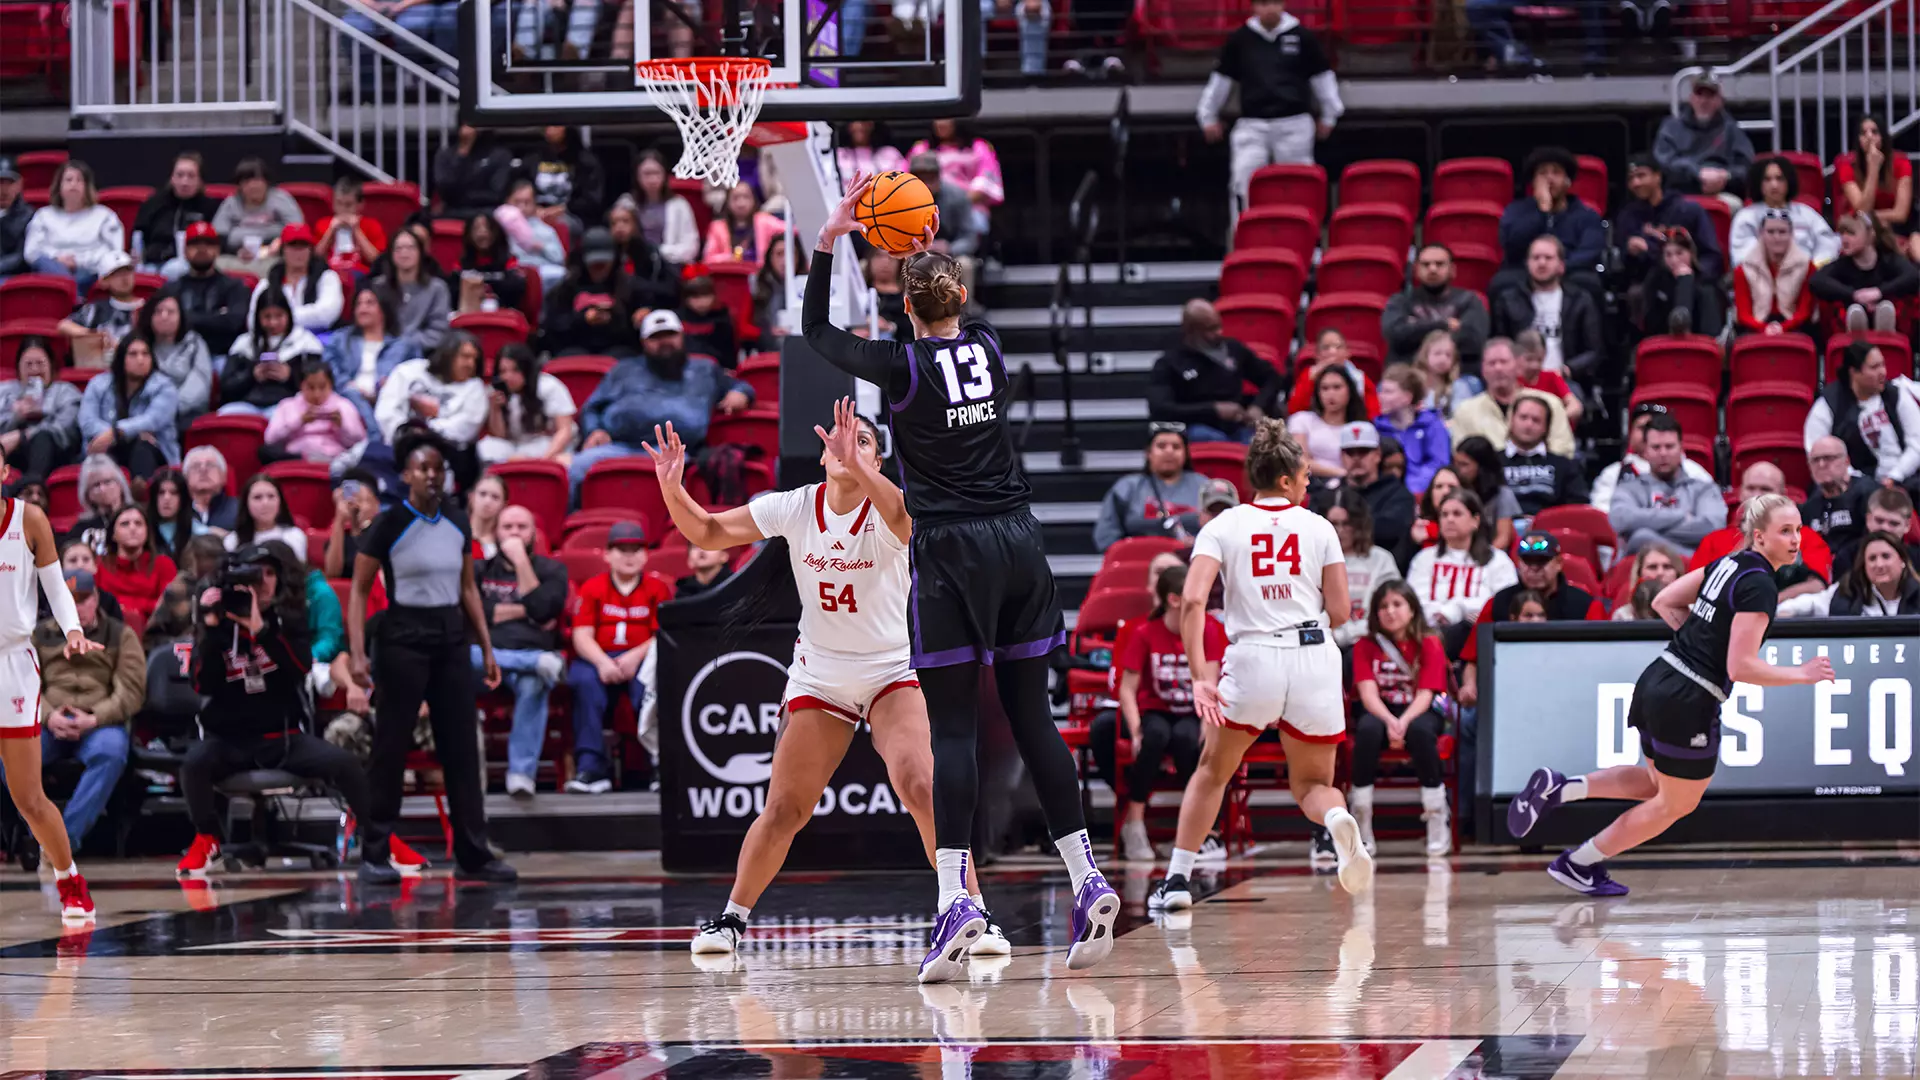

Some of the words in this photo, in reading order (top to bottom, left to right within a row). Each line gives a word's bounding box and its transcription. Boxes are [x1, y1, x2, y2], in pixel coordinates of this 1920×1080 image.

[935, 343, 993, 403] 13
[946, 400, 997, 428] PRINCE
[803, 552, 828, 573] Lady
[830, 558, 874, 572] Raiders
[1251, 533, 1301, 577] 24
[1261, 584, 1292, 600] WYNN
[1702, 556, 1739, 601] 10
[819, 581, 858, 613] 54
[613, 621, 628, 645] 1
[1766, 643, 1920, 665] CERVEZ
[1597, 680, 1764, 769] DS
[1814, 678, 1912, 776] EQ
